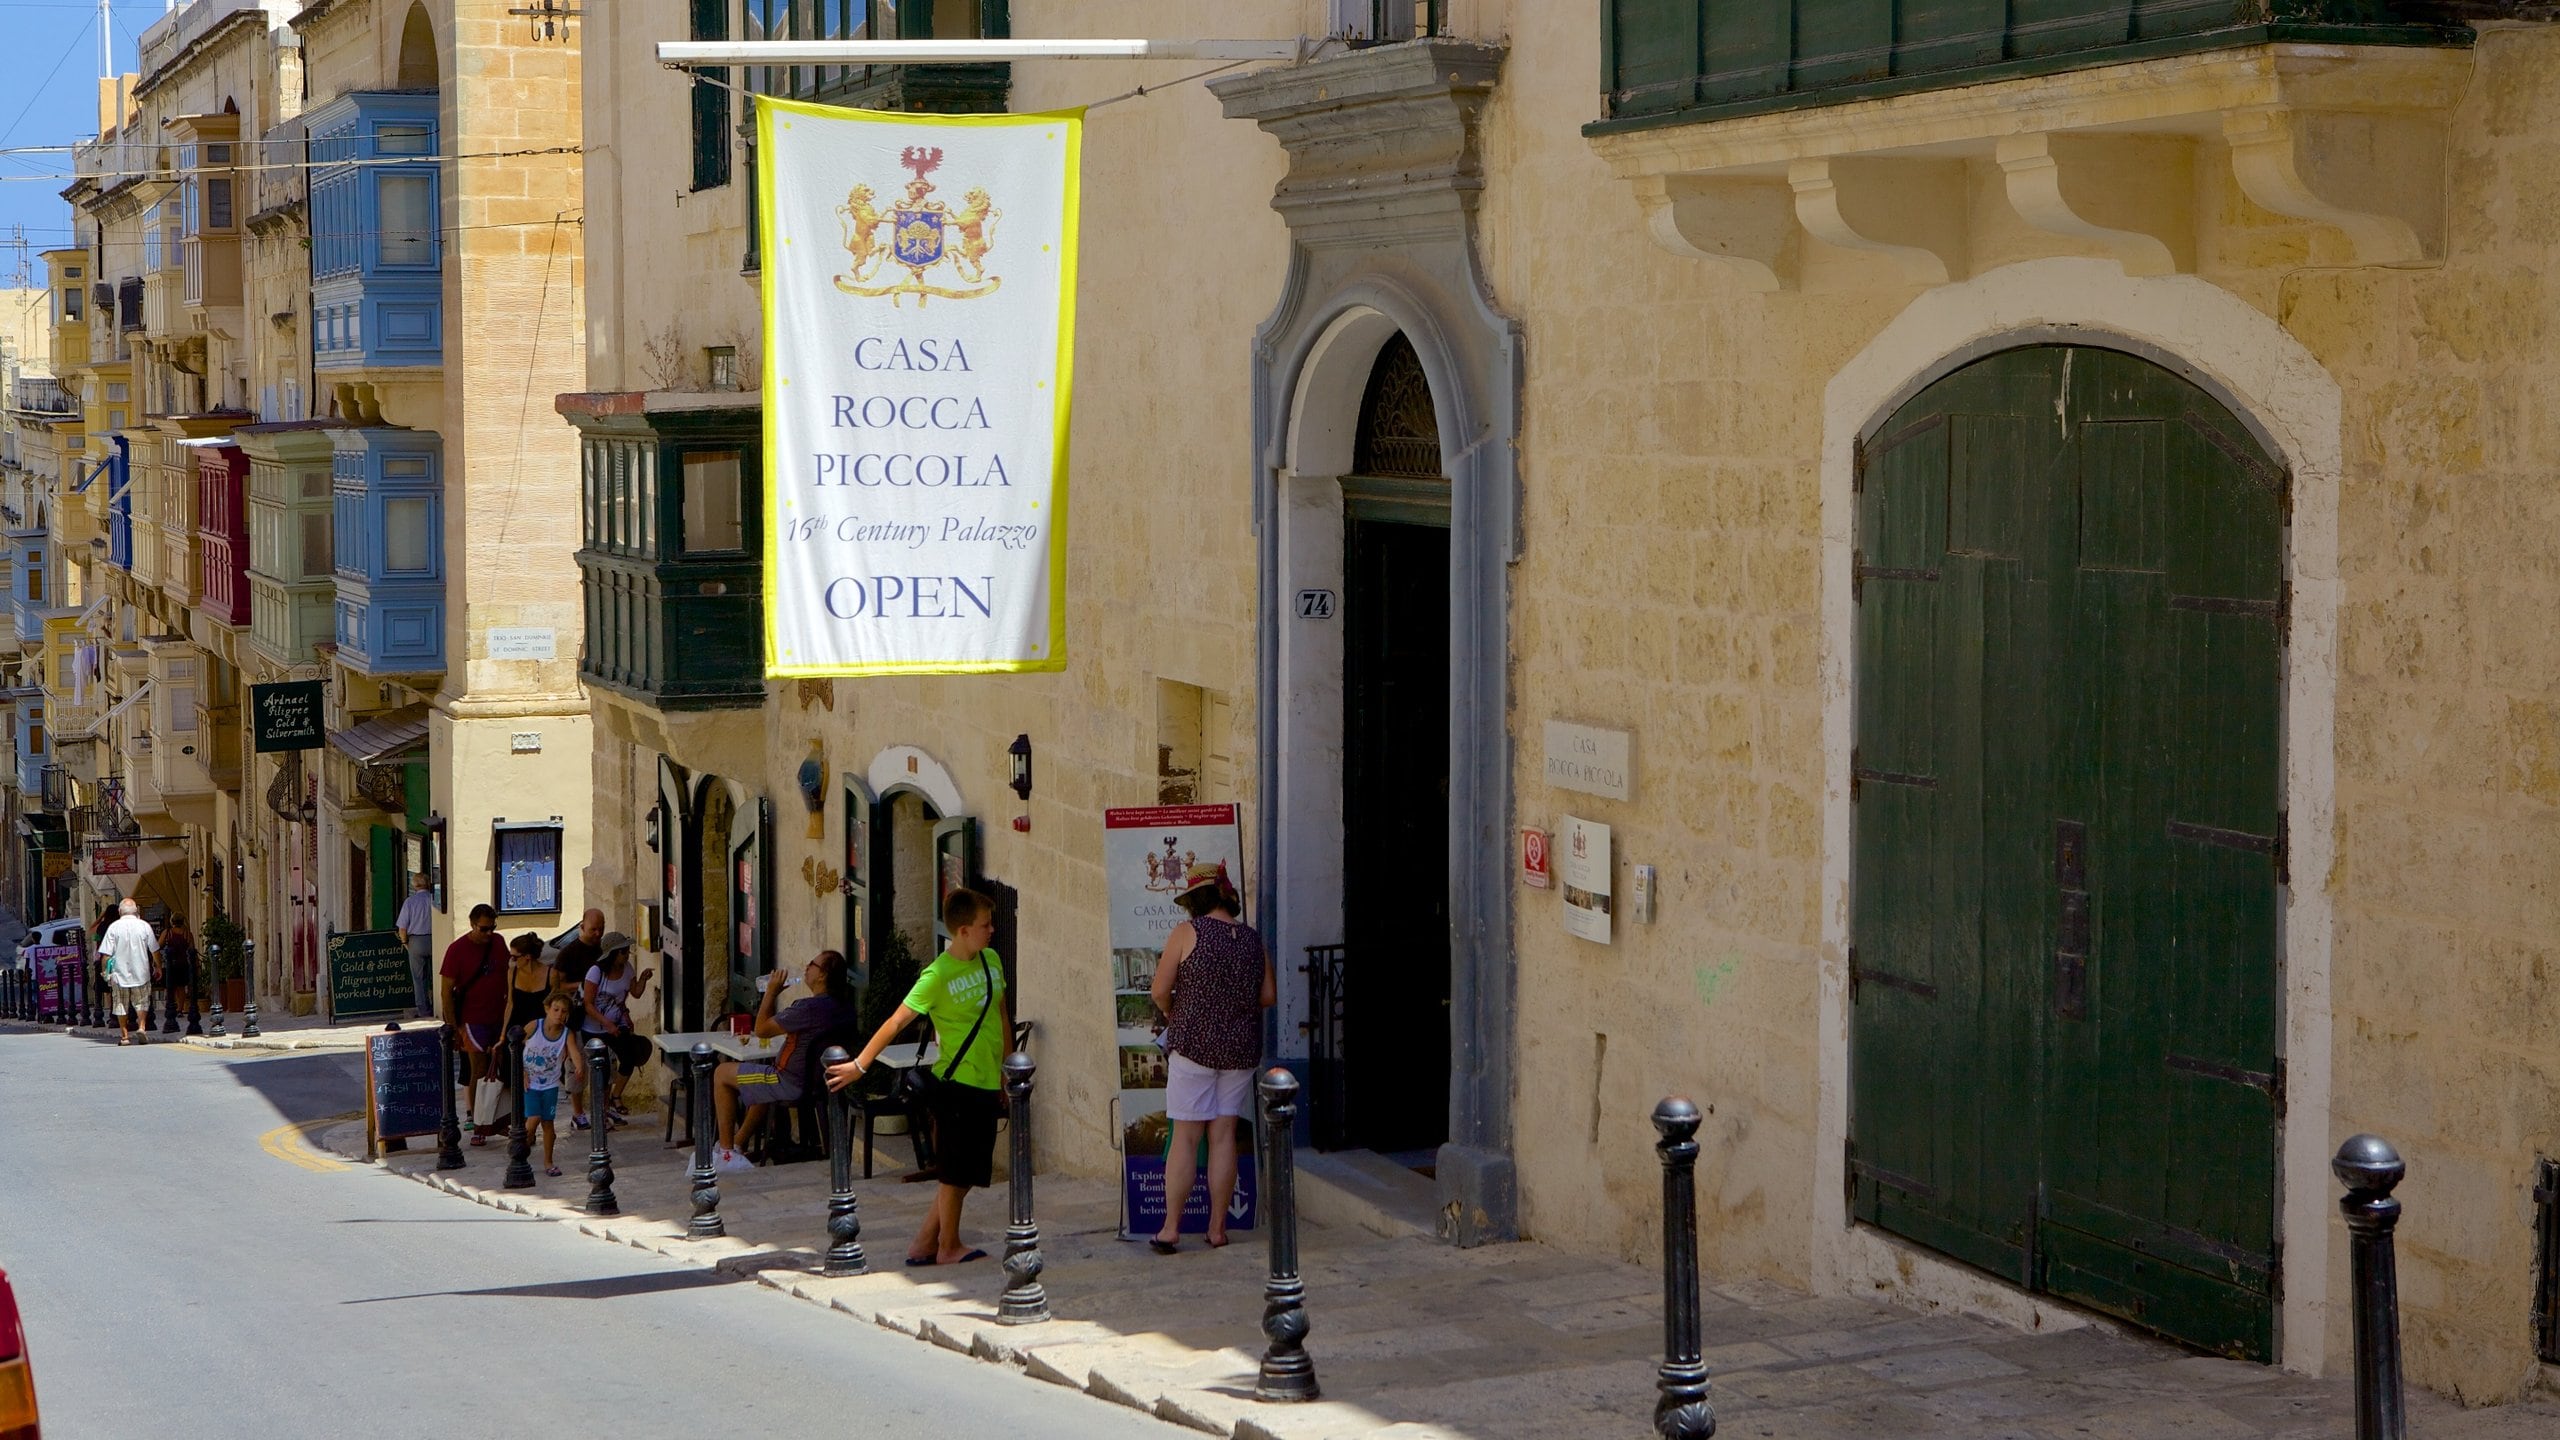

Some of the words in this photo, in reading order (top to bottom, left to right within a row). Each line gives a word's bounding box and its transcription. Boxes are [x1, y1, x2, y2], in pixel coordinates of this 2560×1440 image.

[854, 337, 974, 372] CASA
[831, 395, 992, 430] ROCCA
[812, 453, 1012, 488] PICCOLA
[788, 514, 829, 542] 16th
[837, 516, 931, 550] Century
[938, 516, 1037, 551] Palazzo
[824, 575, 996, 620] OPEN
[1303, 593, 1329, 616] 74
[263, 692, 309, 707] Ardnael
[268, 705, 310, 718] Filigree
[275, 718, 296, 728] Gold
[265, 725, 315, 739] Silversmith
[1573, 735, 1597, 756] CASA
[1548, 757, 1580, 778] ROCCA
[1583, 764, 1623, 789] PICCOLA
[1134, 904, 1166, 917] CASA
[334, 949, 356, 962] You
[357, 949, 376, 958] can
[341, 961, 365, 973] Gold
[367, 960, 376, 972] &
[377, 959, 405, 970] Silver
[339, 974, 374, 990] filigree
[376, 971, 406, 983] works
[335, 987, 371, 1000] worked
[373, 986, 386, 999] by
[1144, 1195, 1165, 1203] over
[1140, 1206, 1167, 1215] below
